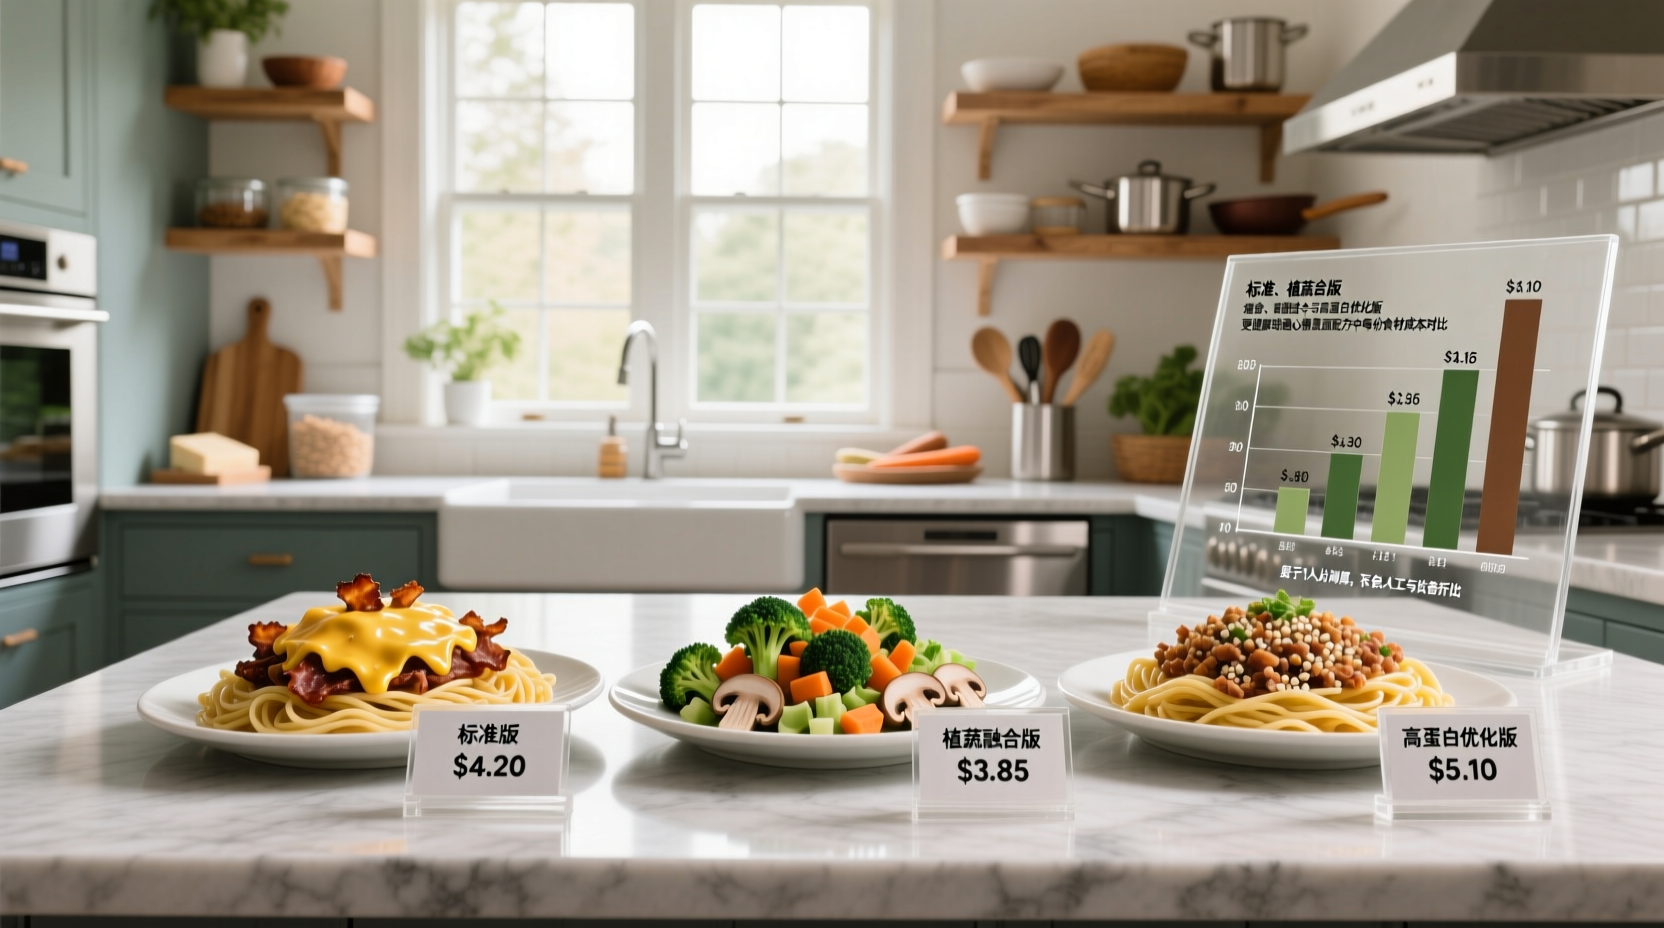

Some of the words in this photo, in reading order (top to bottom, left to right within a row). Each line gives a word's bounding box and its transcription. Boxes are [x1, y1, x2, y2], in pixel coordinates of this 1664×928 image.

[457, 723, 520, 745] 标准版
[942, 727, 1041, 750] 植蔬融合版
[1401, 726, 1518, 748] 高蛋白优化版
[453, 752, 526, 780] $4.20
[957, 756, 1029, 785] $3.85
[1428, 755, 1498, 784] $5.10
